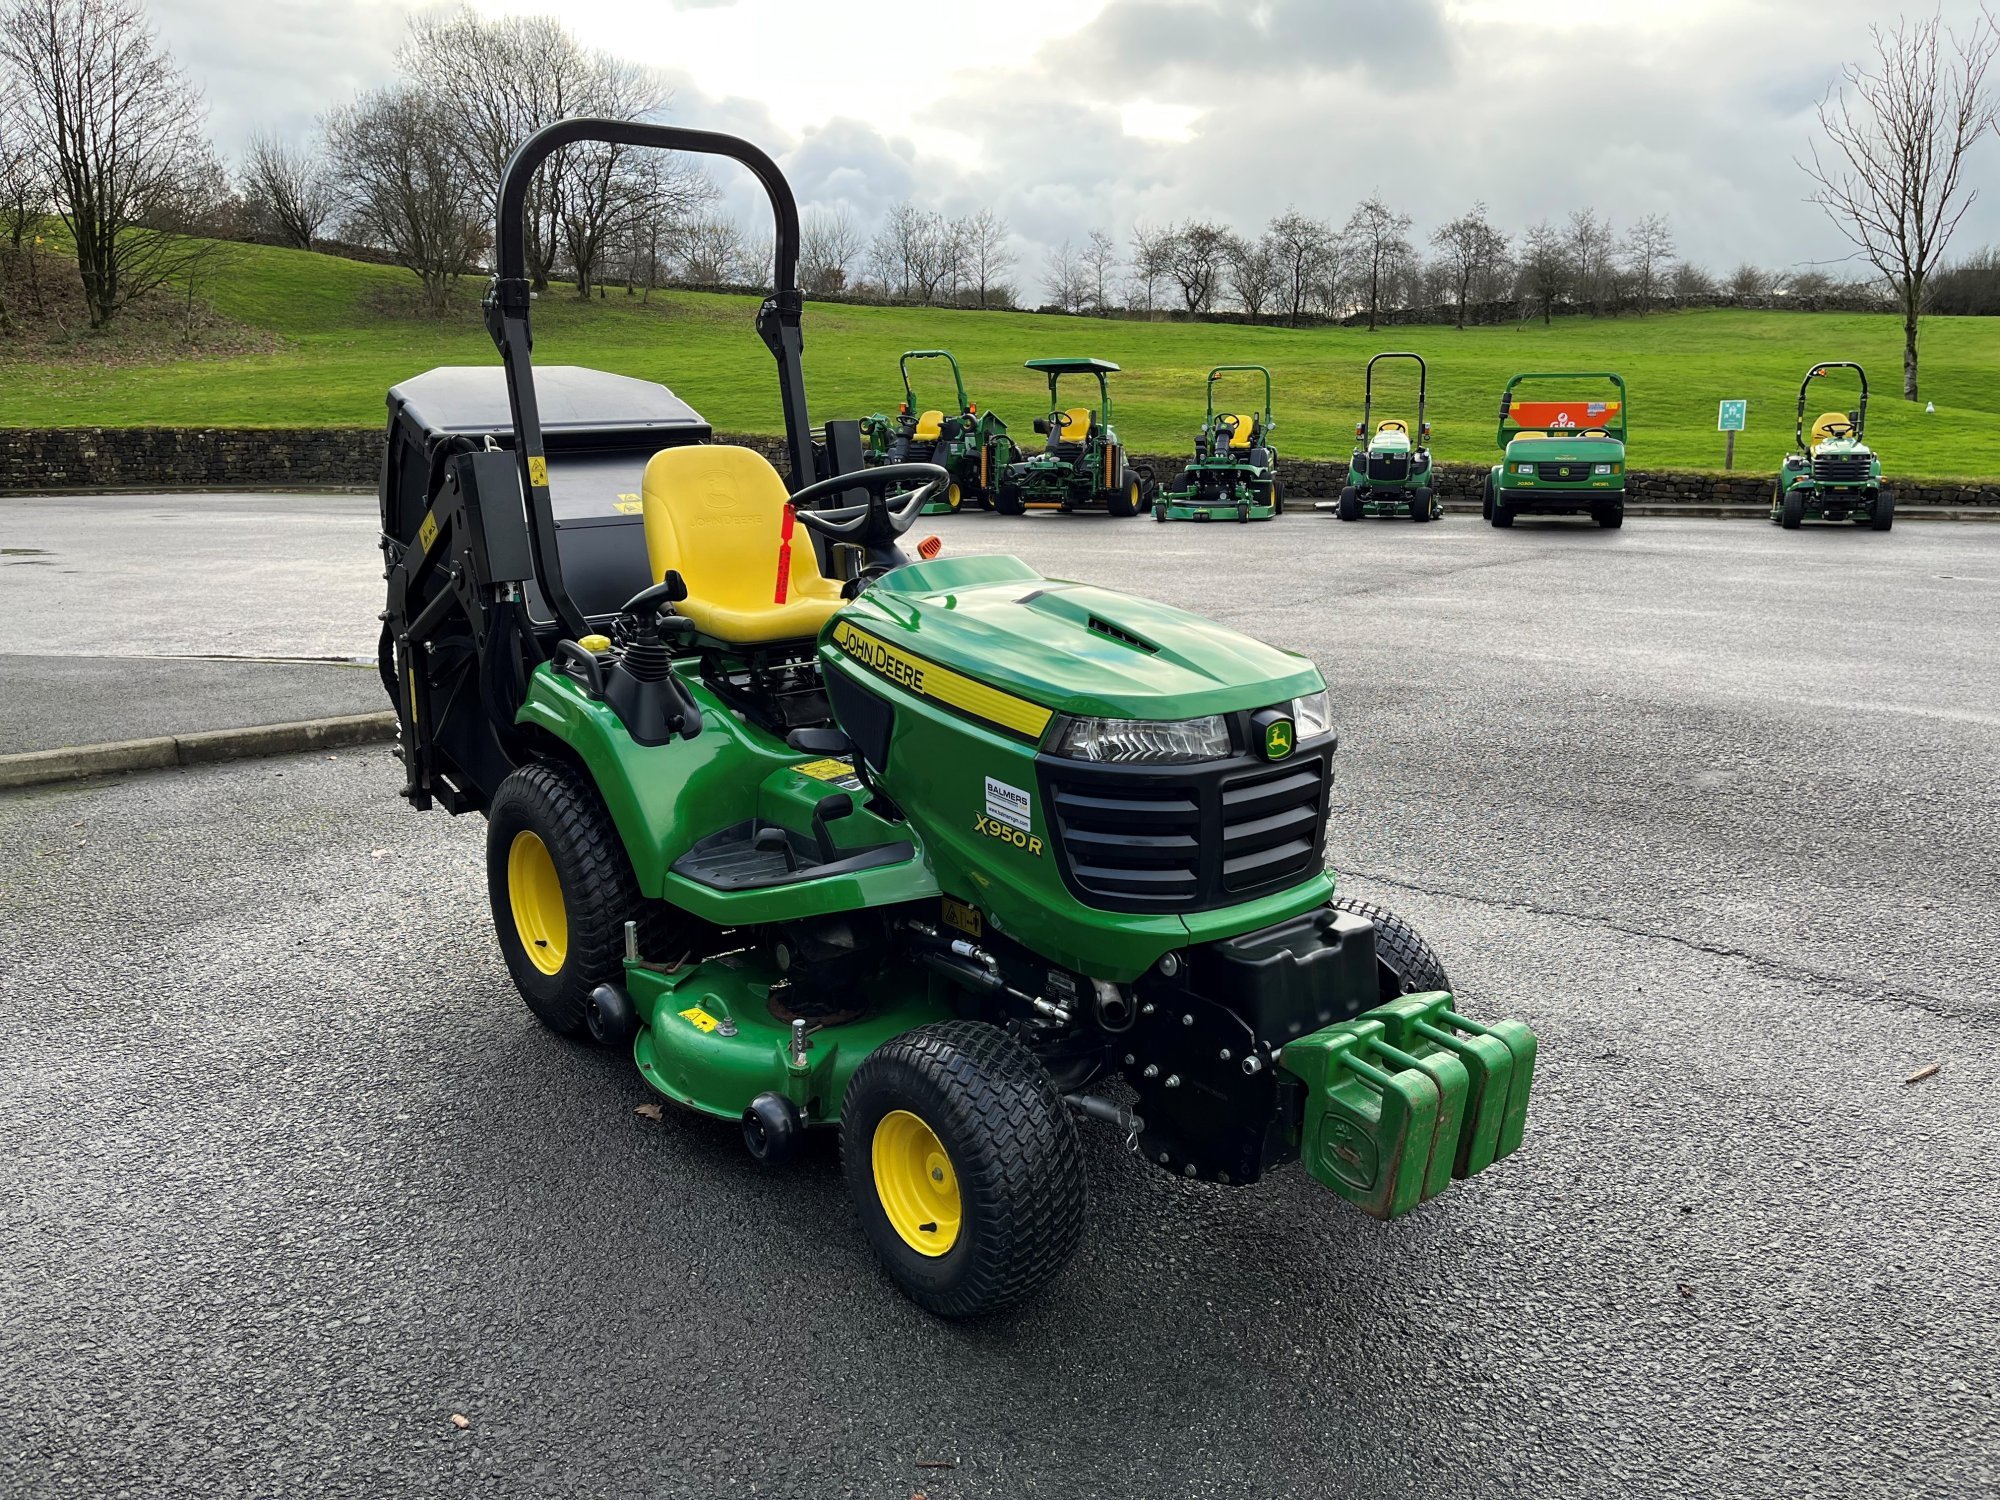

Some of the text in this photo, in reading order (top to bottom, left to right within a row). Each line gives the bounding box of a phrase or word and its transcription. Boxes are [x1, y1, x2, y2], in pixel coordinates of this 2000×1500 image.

[721, 514, 764, 528] DEERE
[841, 626, 925, 691] JOHN DEERE
[987, 783, 1028, 806] BALMERS
